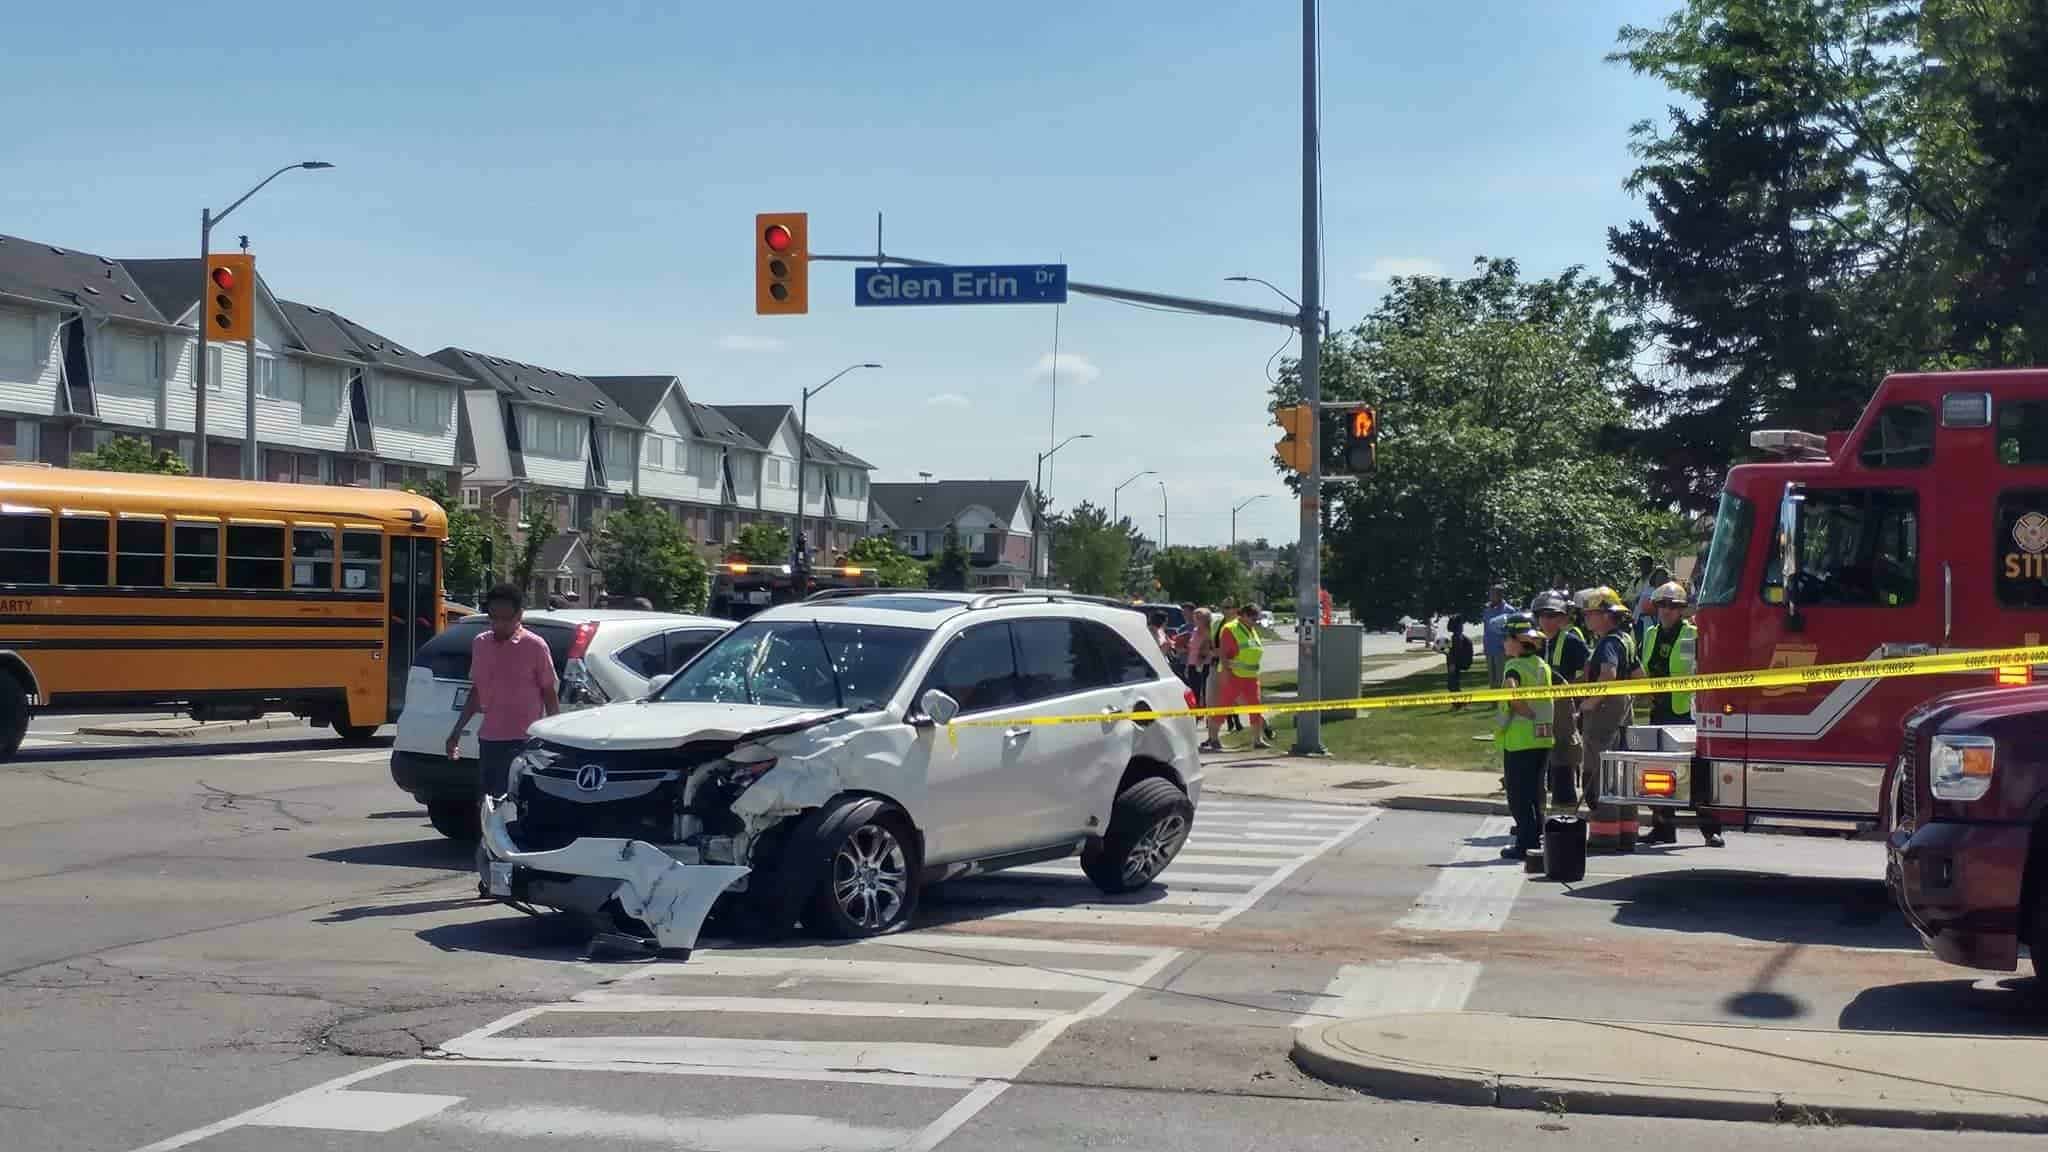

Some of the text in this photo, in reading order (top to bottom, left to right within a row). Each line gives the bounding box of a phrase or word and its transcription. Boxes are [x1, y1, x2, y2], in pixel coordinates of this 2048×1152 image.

[867, 270, 1055, 298] Glen Erin Dr
